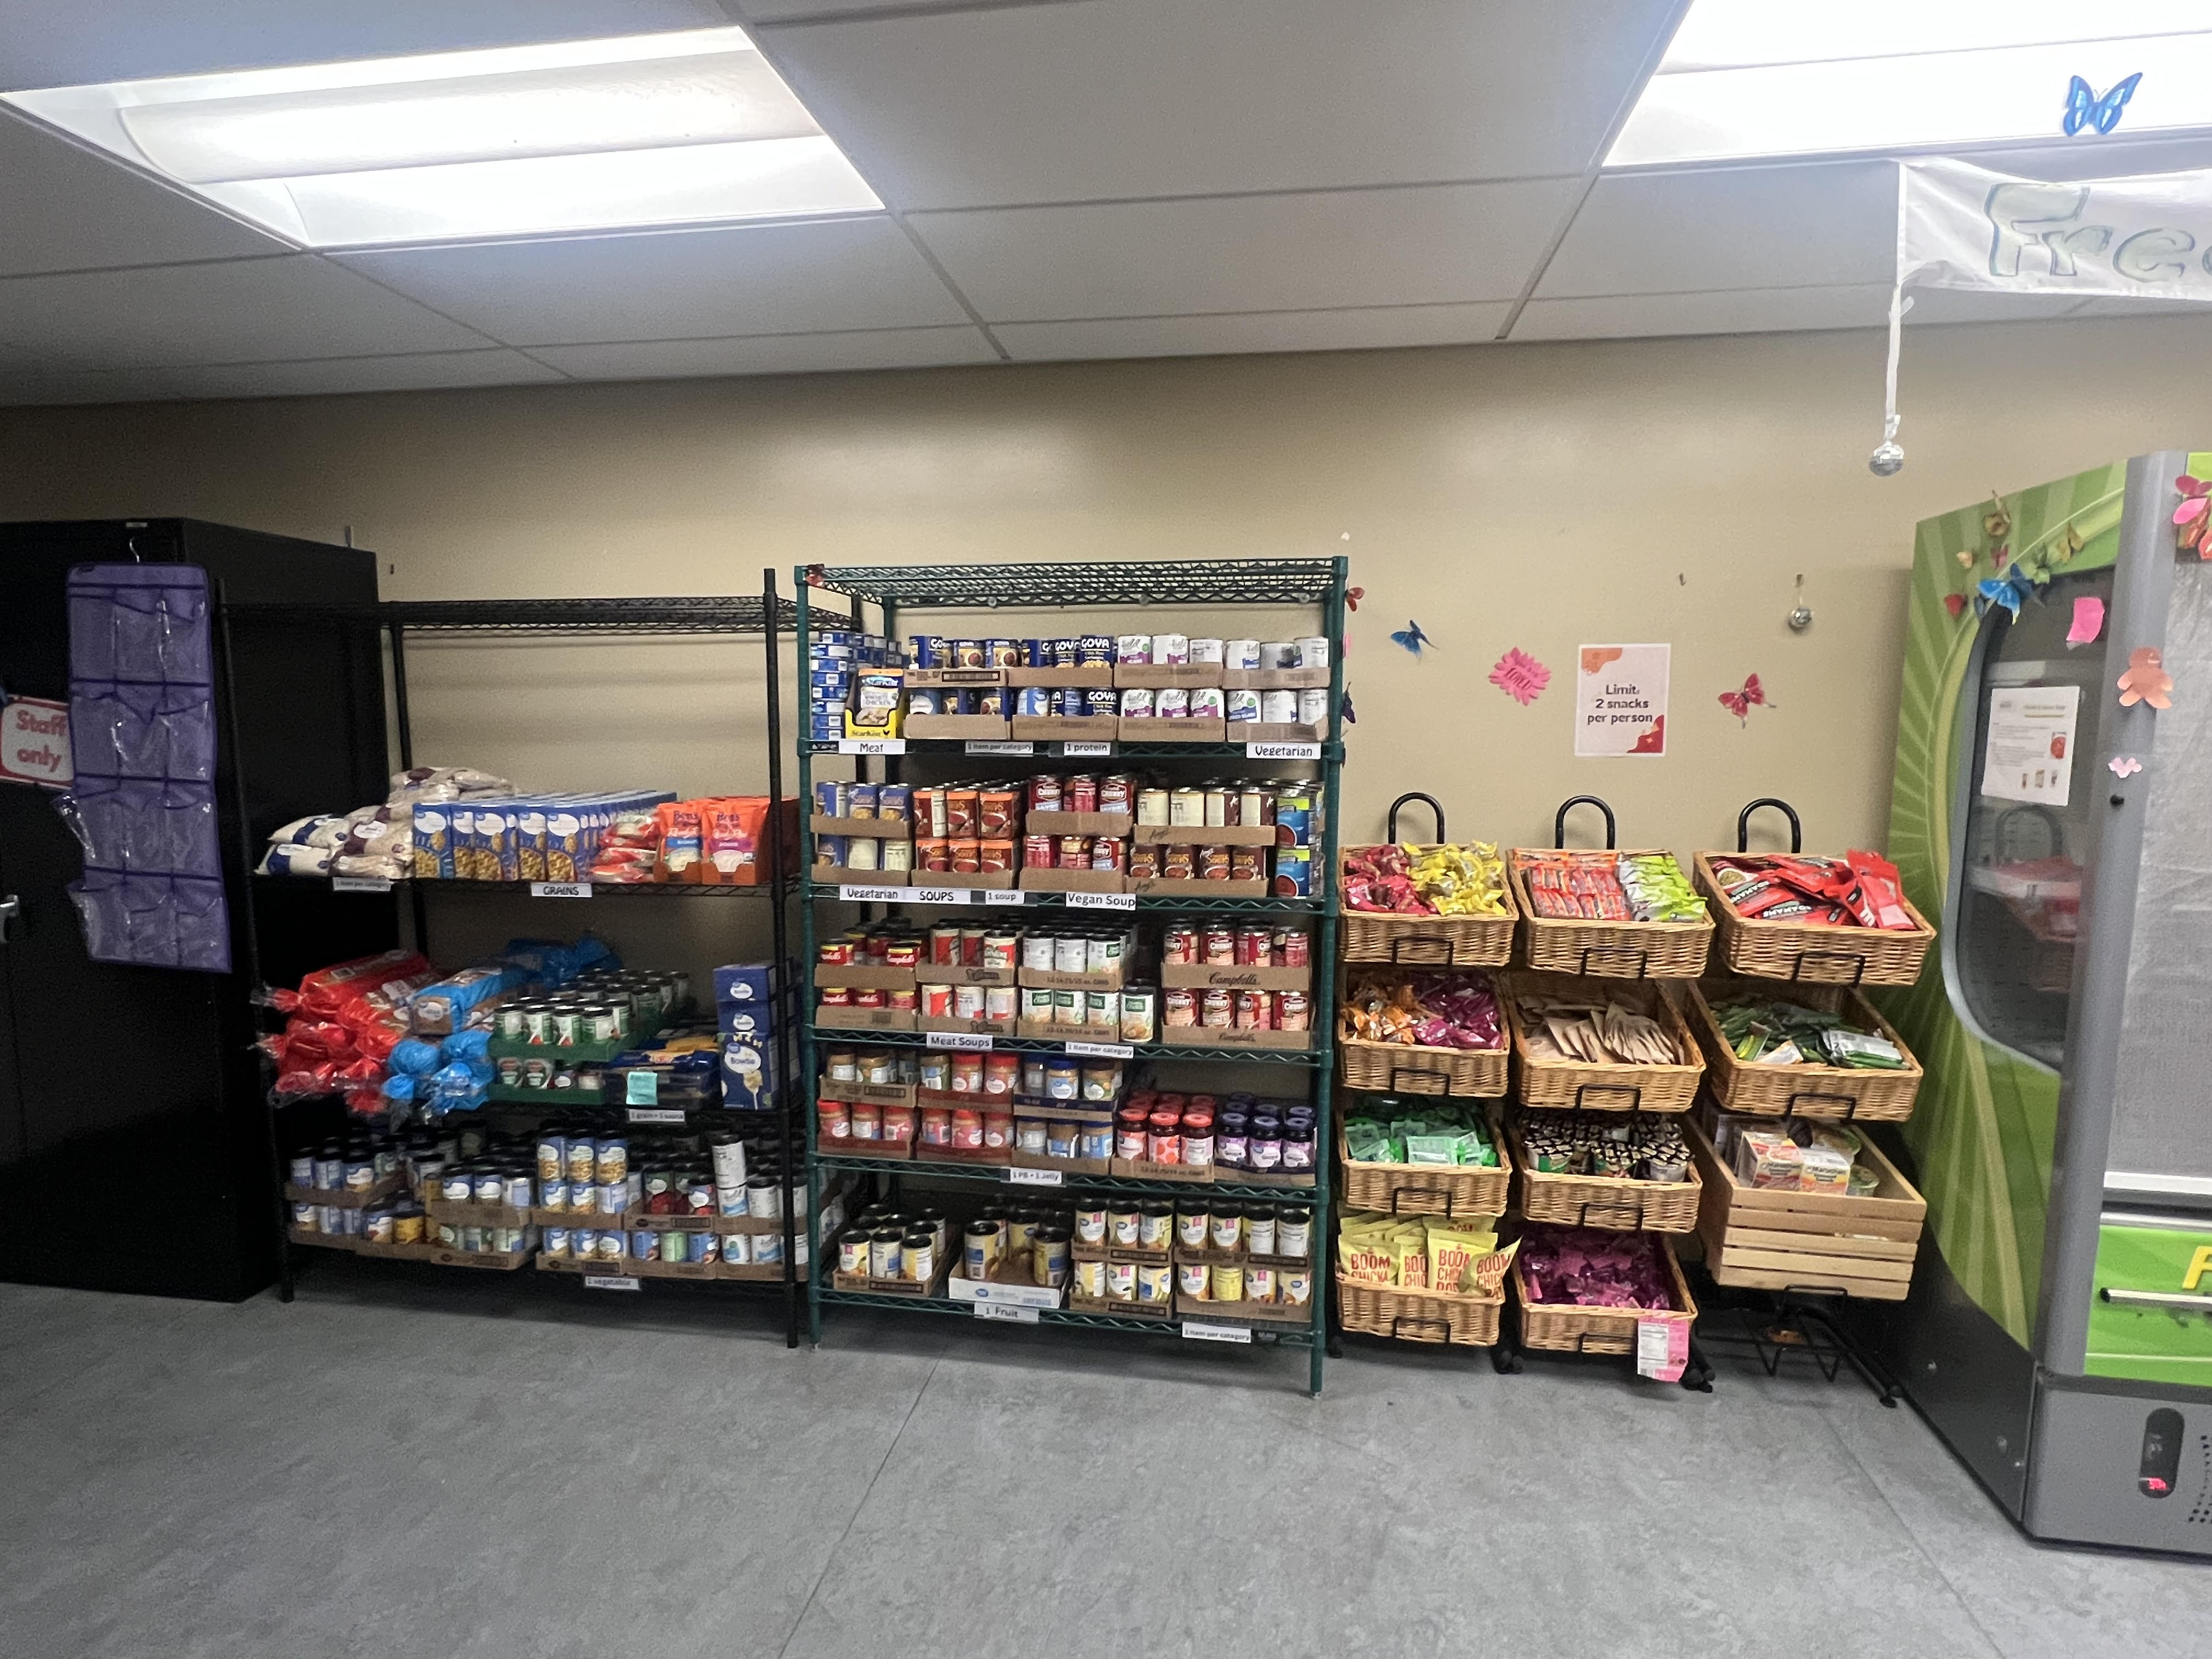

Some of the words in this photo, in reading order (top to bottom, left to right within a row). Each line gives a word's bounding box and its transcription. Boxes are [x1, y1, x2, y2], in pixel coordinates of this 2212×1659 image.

[1081, 639, 1109, 648] GOYA
[1088, 691, 1116, 701] GOYA
[1595, 699, 1604, 709] 2
[1607, 698, 1649, 709] snacks
[1587, 715, 1607, 725] per
[1611, 714, 1653, 724] person
[860, 743, 883, 753] Meat
[1074, 743, 1108, 753] protein
[1255, 745, 1312, 757] Vegetarian
[17, 744, 61, 772] only
[848, 888, 898, 899] Vegetarian
[919, 891, 954, 901] SOUPS
[995, 894, 1016, 902] soup
[1068, 893, 1103, 906] Vegan
[1105, 895, 1136, 908] Soup
[931, 1036, 956, 1045] Meat
[958, 1037, 990, 1048] Soups
[1351, 1254, 1391, 1270] BOOM
[996, 1307, 1018, 1318] Fruit
